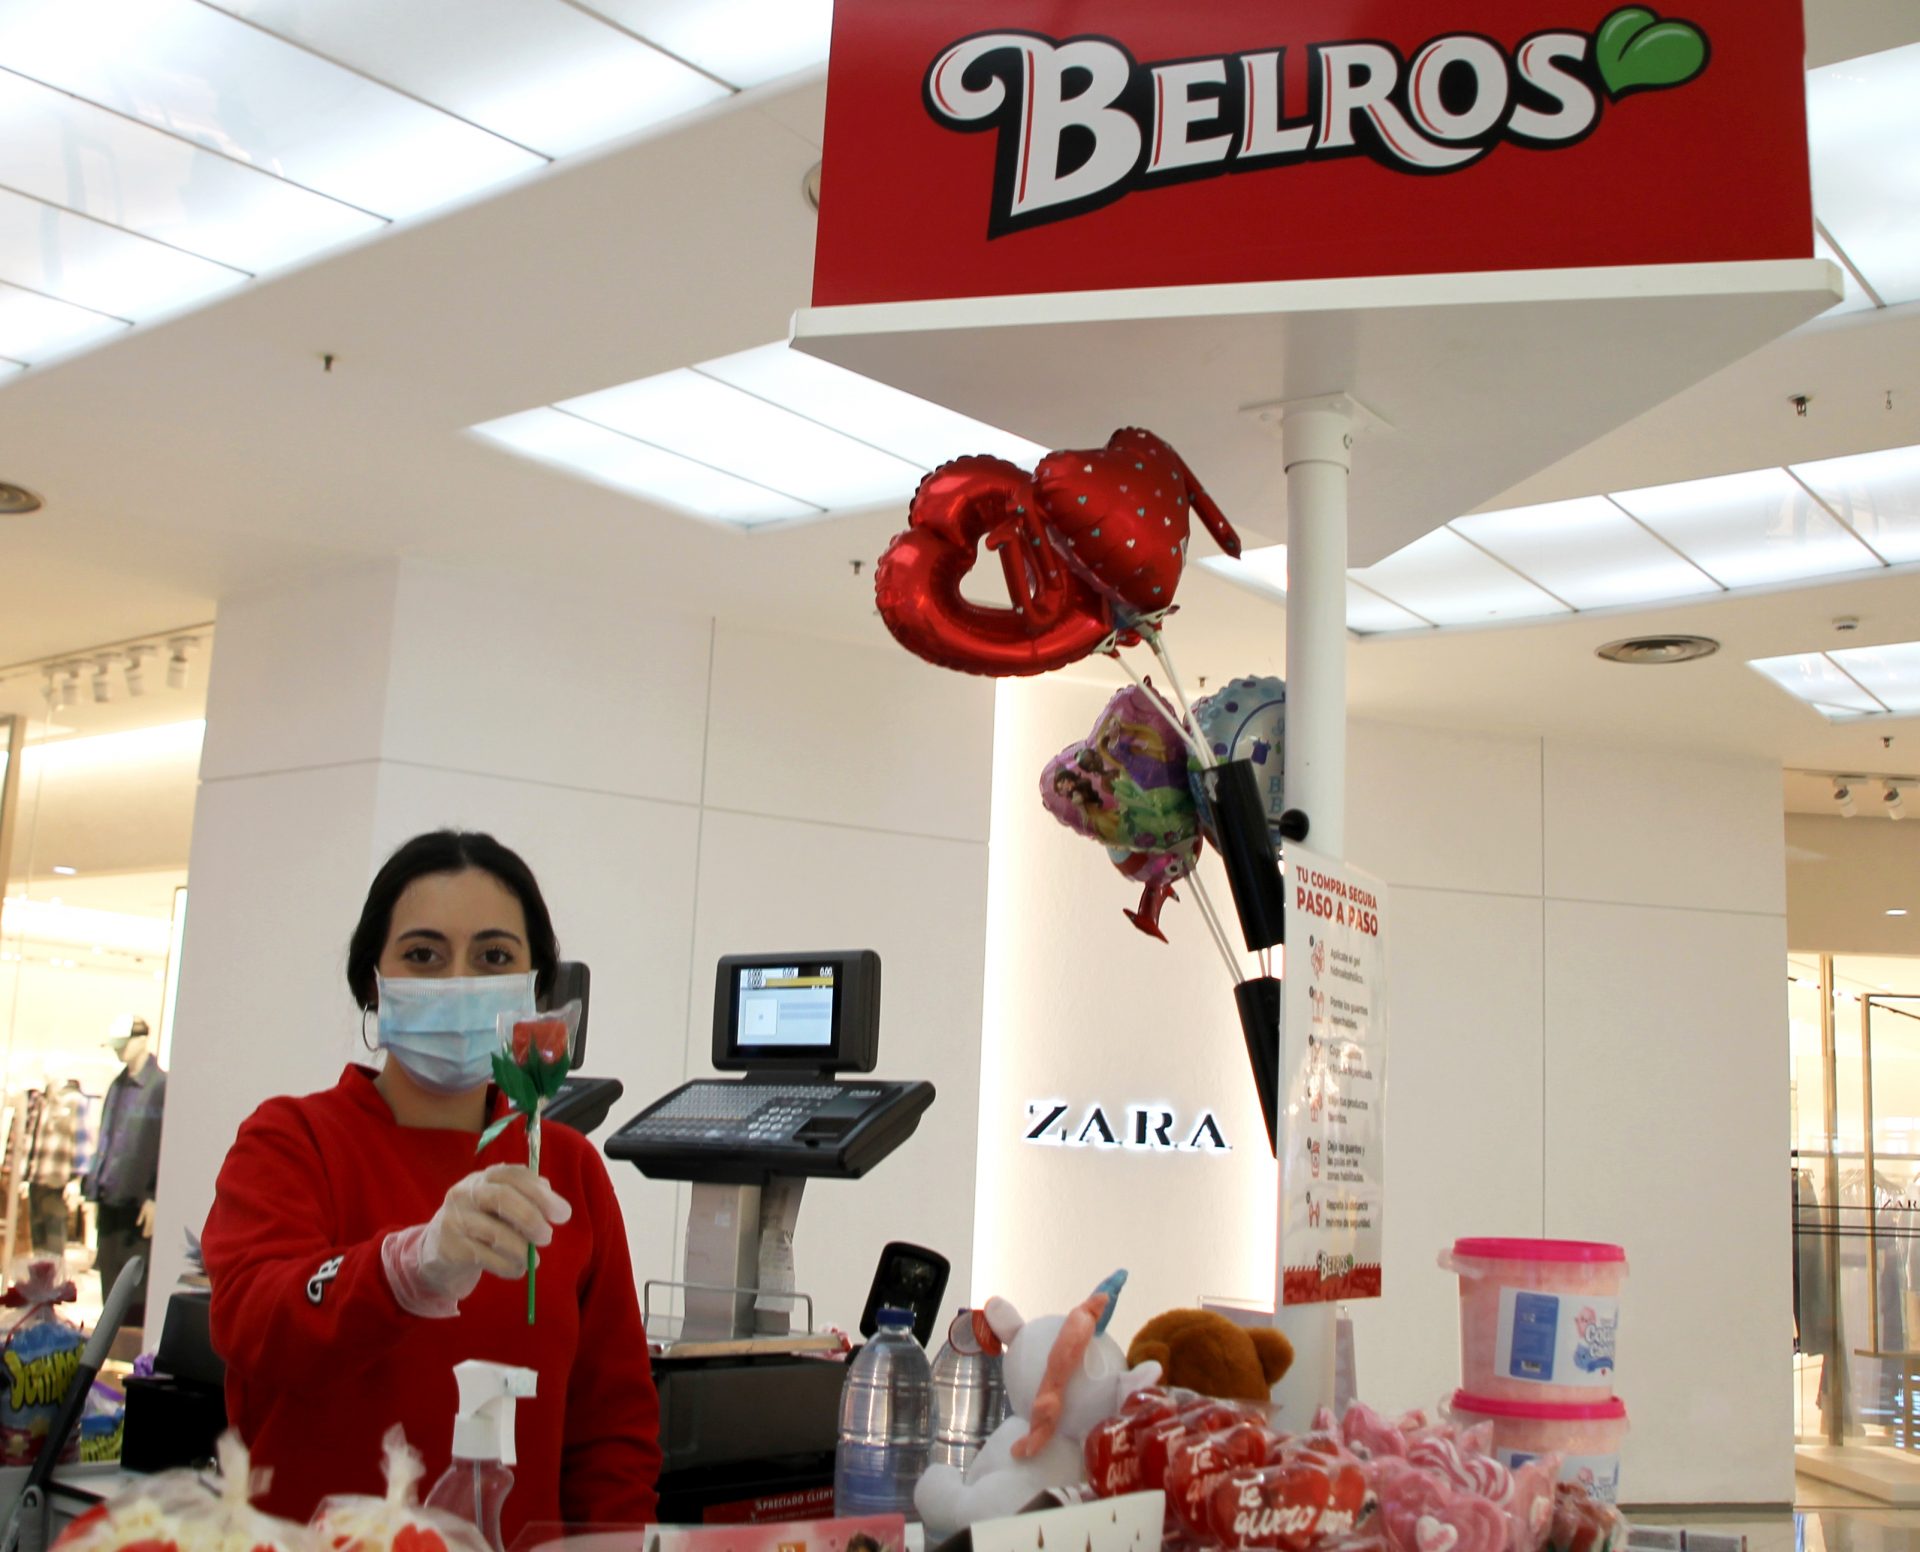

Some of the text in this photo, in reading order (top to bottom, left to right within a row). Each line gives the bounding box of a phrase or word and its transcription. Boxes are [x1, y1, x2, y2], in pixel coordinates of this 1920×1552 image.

[926, 31, 1599, 220] BELROS
[1296, 865, 1378, 910] TU COMPRA SEGURA
[1296, 886, 1379, 937] PASO A PASO
[1026, 1103, 1234, 1150] ZARA
[1882, 1199, 1919, 1209] ZAR
[1316, 1250, 1349, 1281] BELROS
[807, 1489, 834, 1502] CLIENT
[1232, 1473, 1265, 1508] Te
